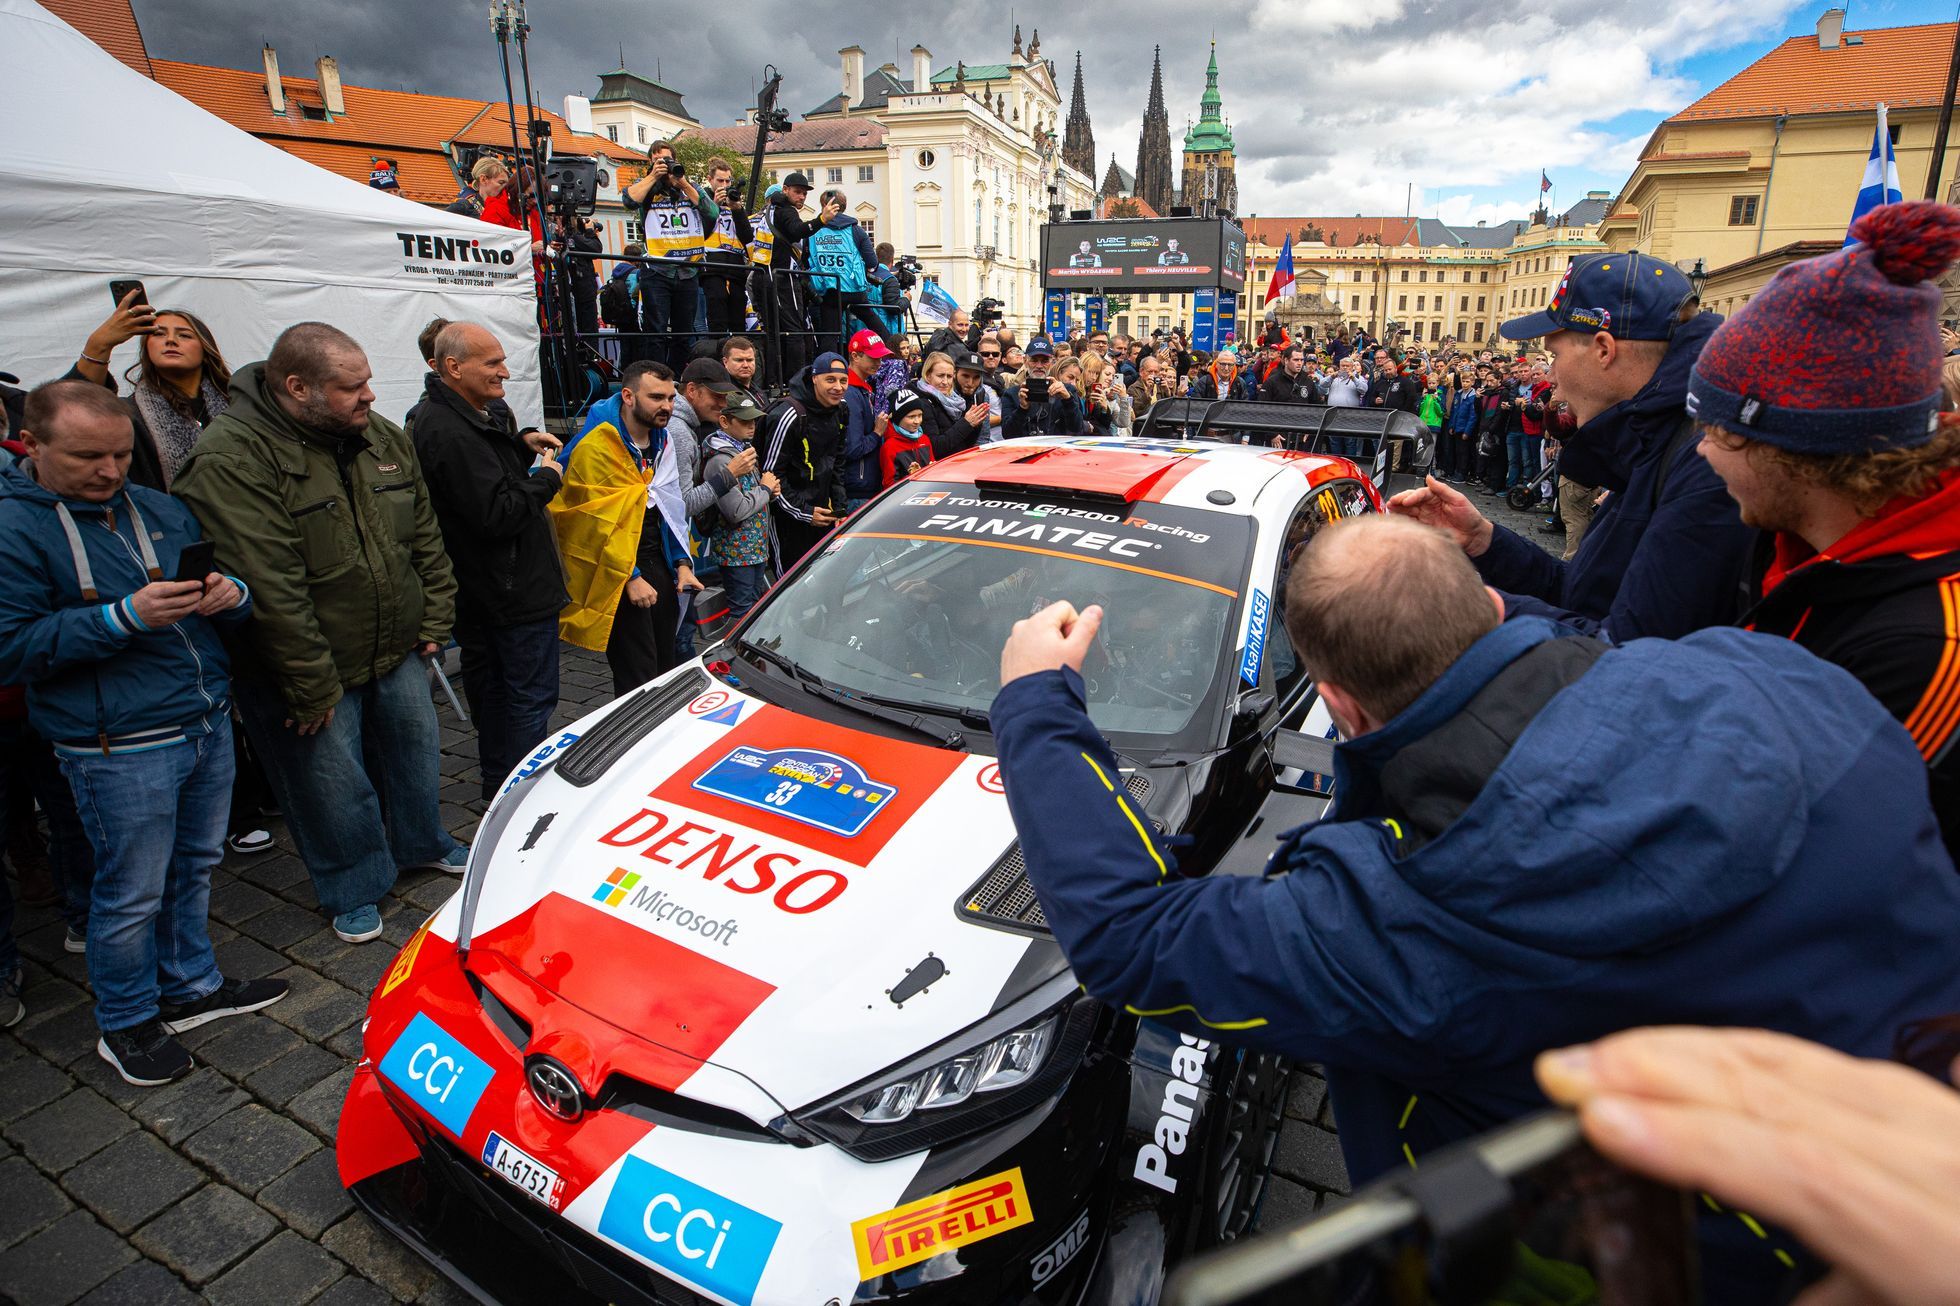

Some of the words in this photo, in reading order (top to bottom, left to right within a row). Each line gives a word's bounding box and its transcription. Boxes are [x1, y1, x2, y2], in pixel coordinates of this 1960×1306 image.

[396, 232, 515, 265] TENTino
[818, 254, 845, 267] 036
[948, 497, 1028, 511] TOYOTA
[1033, 504, 1120, 523] GAZOO
[1123, 517, 1211, 544] Racing
[1243, 592, 1268, 683] AsahiKASEI
[765, 781, 803, 806] 33
[768, 766, 811, 782] RALLY
[597, 808, 849, 914] DENSO
[630, 885, 738, 946] Microsoft
[497, 1149, 549, 1198] A-6752
[554, 1178, 565, 1194] 11
[549, 1195, 560, 1209] 23
[866, 1181, 1018, 1266] PIRELLI
[1031, 1214, 1090, 1282] OMP
